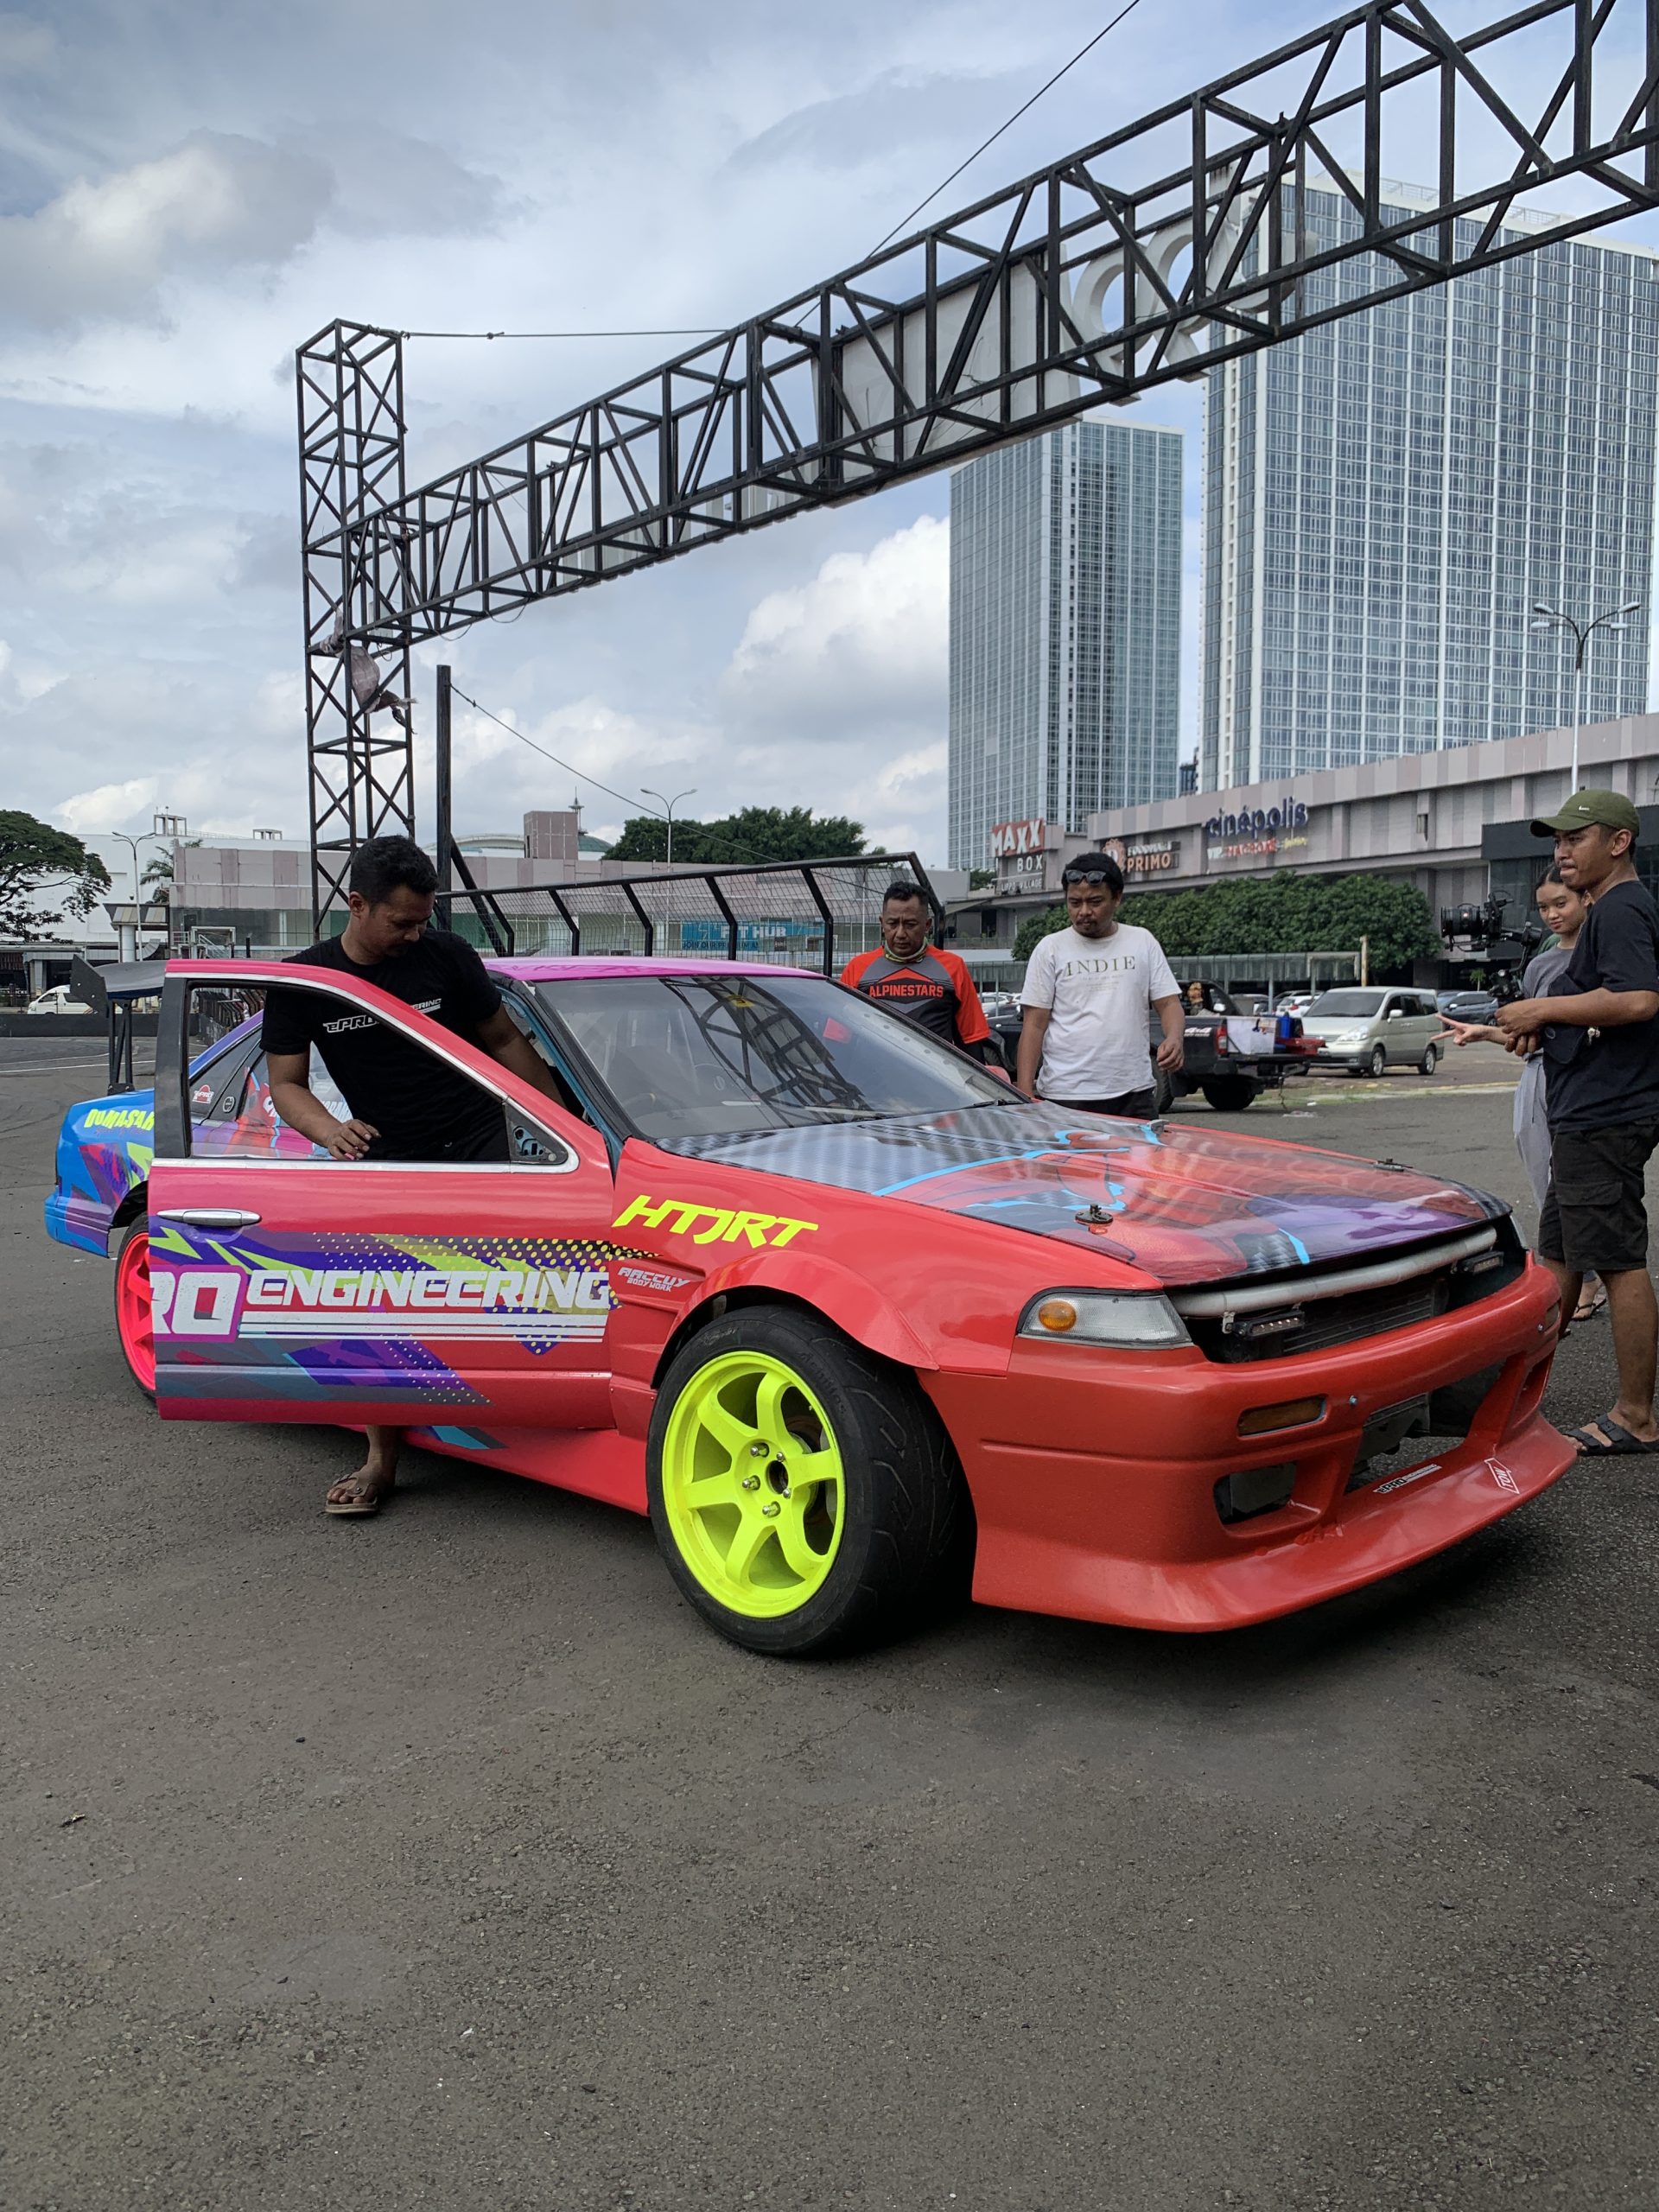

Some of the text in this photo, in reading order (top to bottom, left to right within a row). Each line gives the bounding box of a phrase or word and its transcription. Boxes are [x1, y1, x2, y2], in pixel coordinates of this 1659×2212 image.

[1206, 796, 1308, 839] cinépolis
[990, 820, 1041, 857] MAXX
[1017, 854, 1043, 872] BOX
[1127, 852, 1171, 873] PRIMO
[721, 925, 786, 938] FT HUB
[1066, 956, 1135, 976] INDIE
[868, 984, 944, 998] ALPINESTARS
[611, 1194, 819, 1249] HTJRT
[649, 1281, 673, 1293] WORK
[1494, 1465, 1515, 1489] TOW
